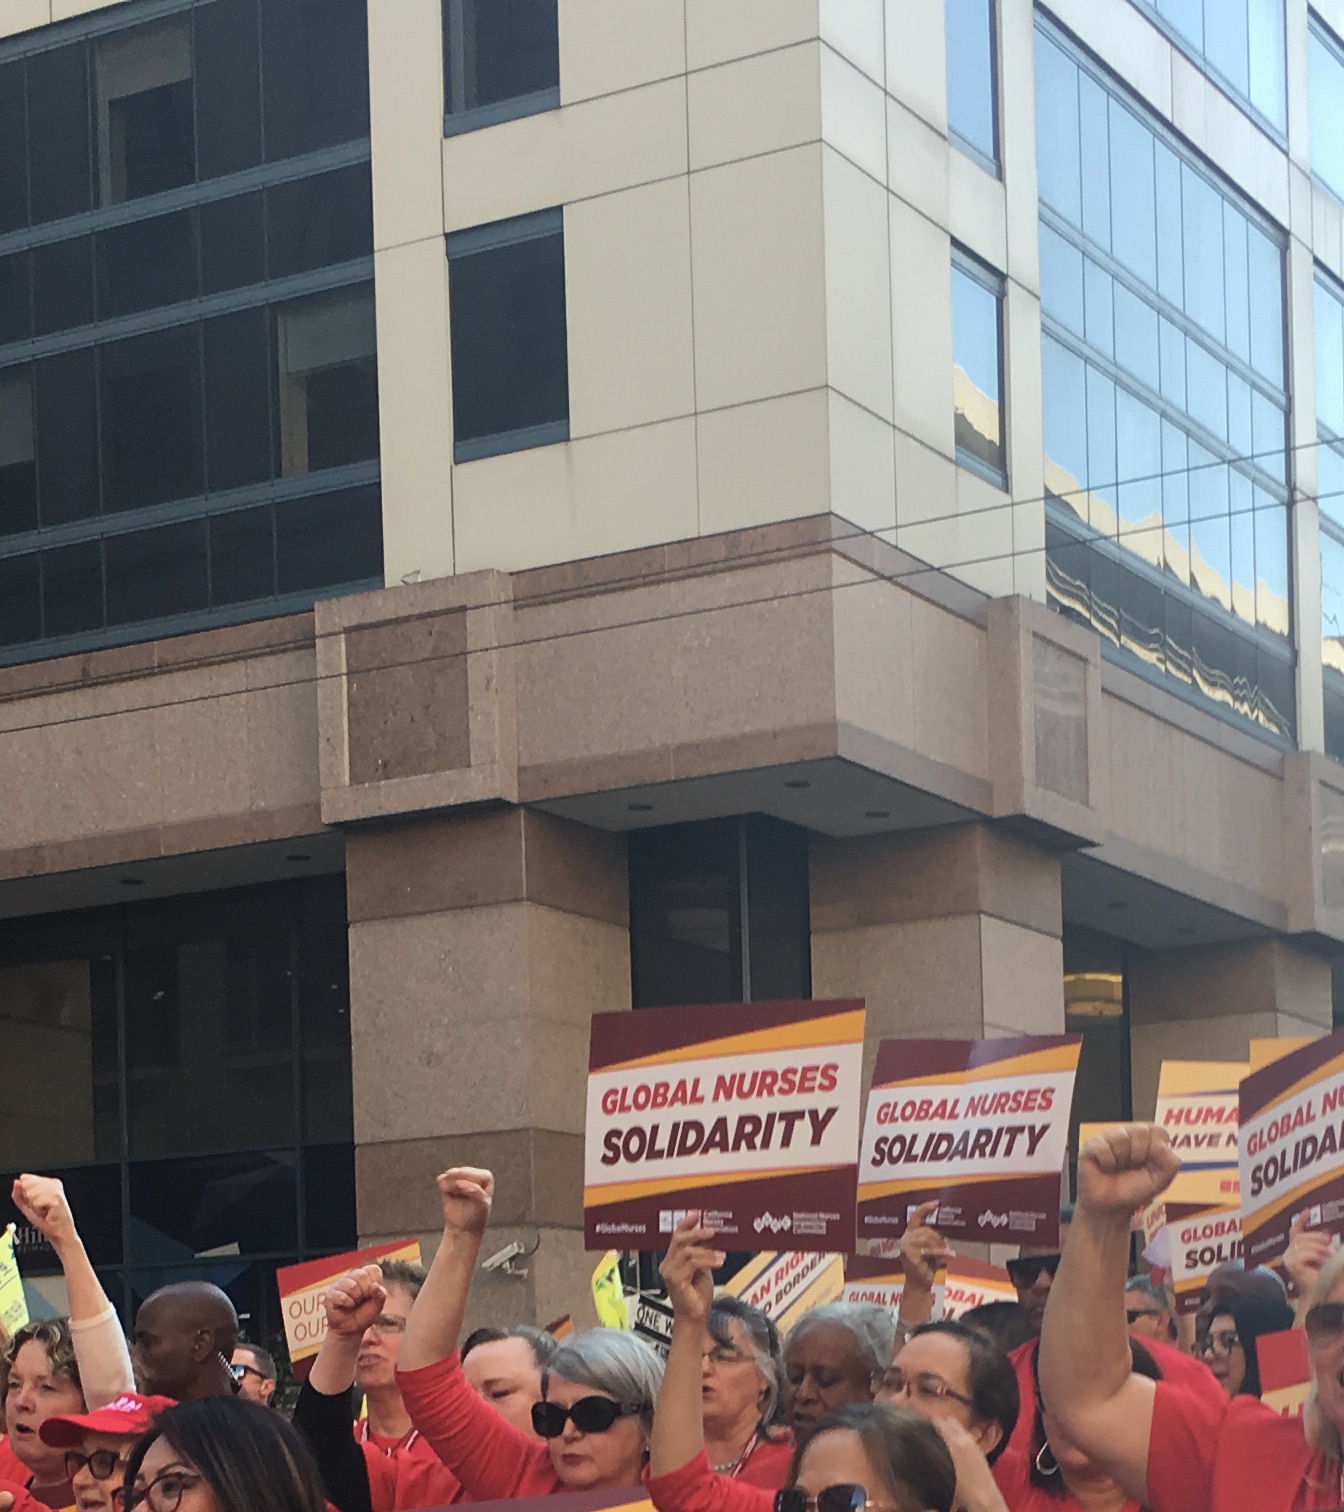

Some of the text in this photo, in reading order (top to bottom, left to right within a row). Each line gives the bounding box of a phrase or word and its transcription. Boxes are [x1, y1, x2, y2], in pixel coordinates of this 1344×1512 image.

[601, 1063, 839, 1116] GLOBAL NURSES
[876, 1087, 1055, 1125] GLOBAL NURSES
[600, 1105, 839, 1165] SOLIDARITY
[1163, 1106, 1239, 1126] HUMA
[1247, 1100, 1316, 1157] GLOBAL
[871, 1123, 1051, 1168] SOLIDARITY
[637, 1304, 660, 1329] ONE
